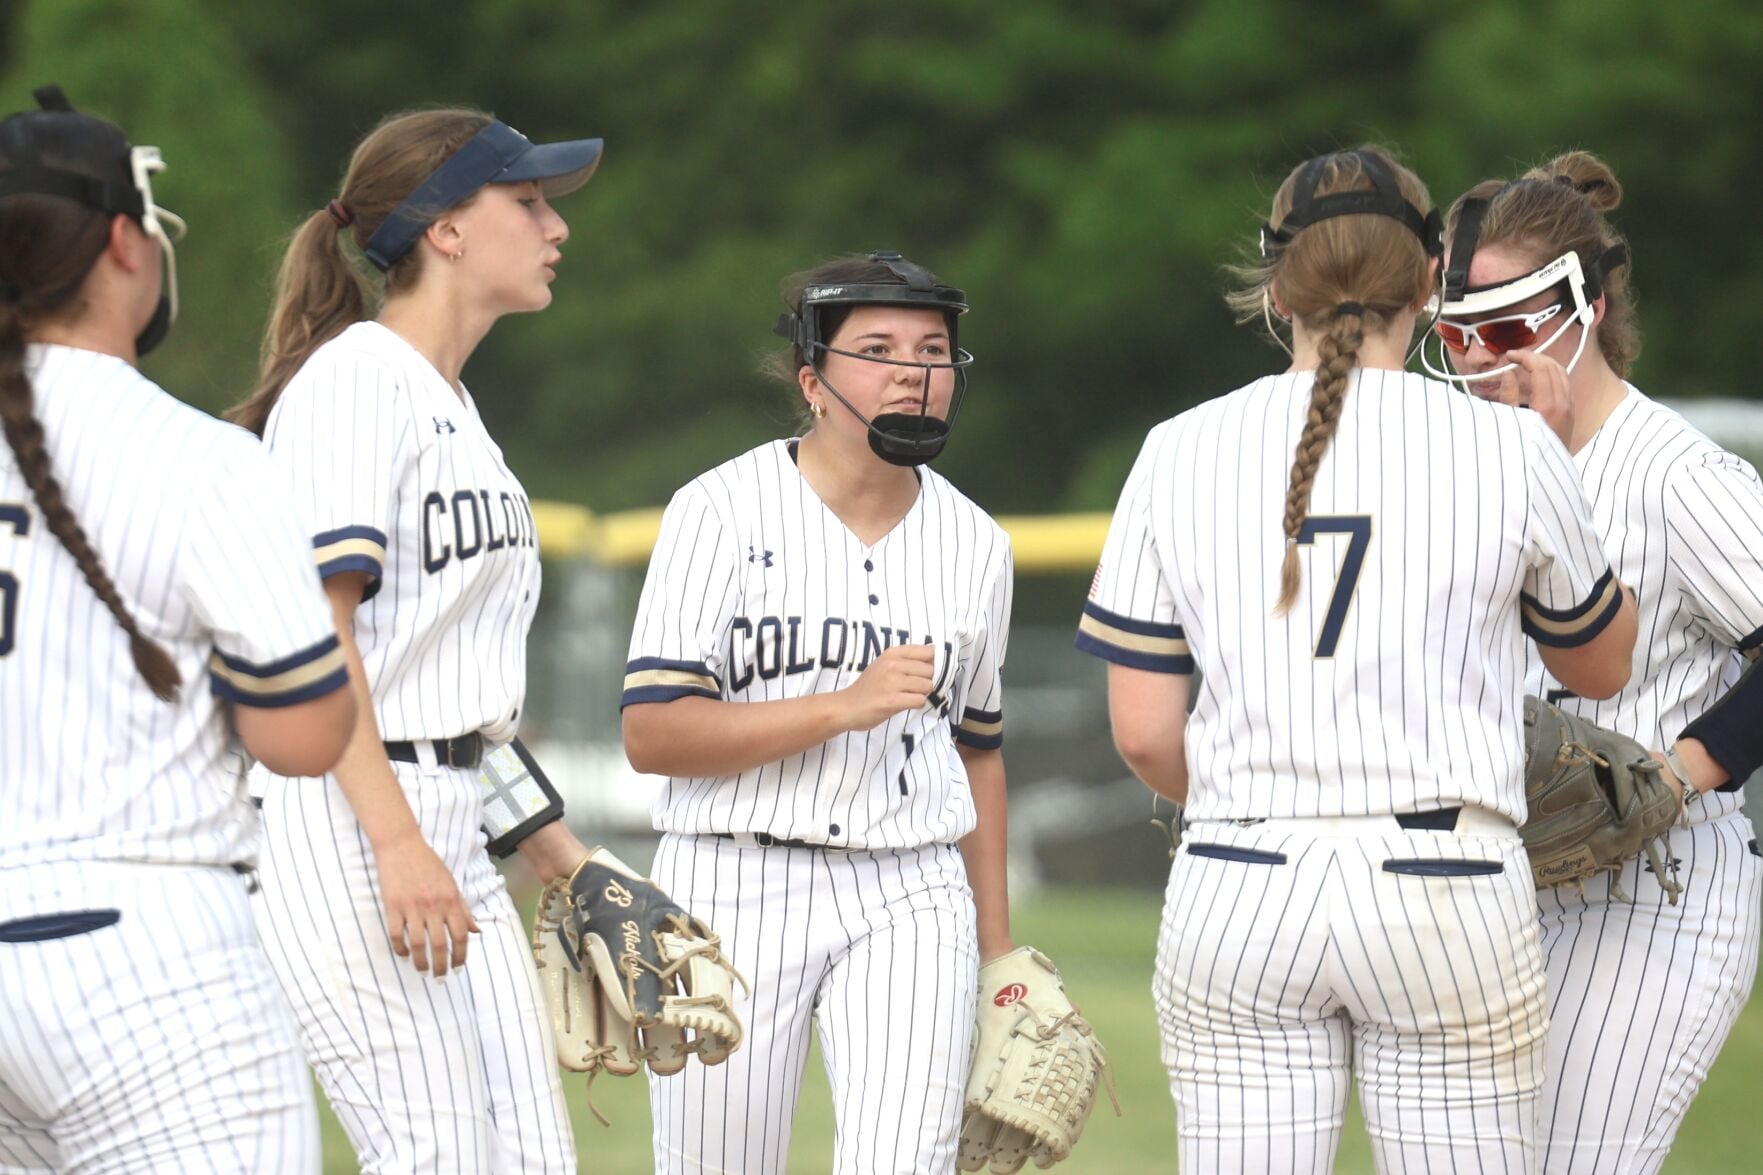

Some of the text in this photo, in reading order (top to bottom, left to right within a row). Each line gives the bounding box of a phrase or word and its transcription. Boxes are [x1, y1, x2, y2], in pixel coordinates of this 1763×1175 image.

[1297, 514, 1374, 660] 7
[729, 615, 952, 719] COLONL
[605, 878, 634, 908] 13
